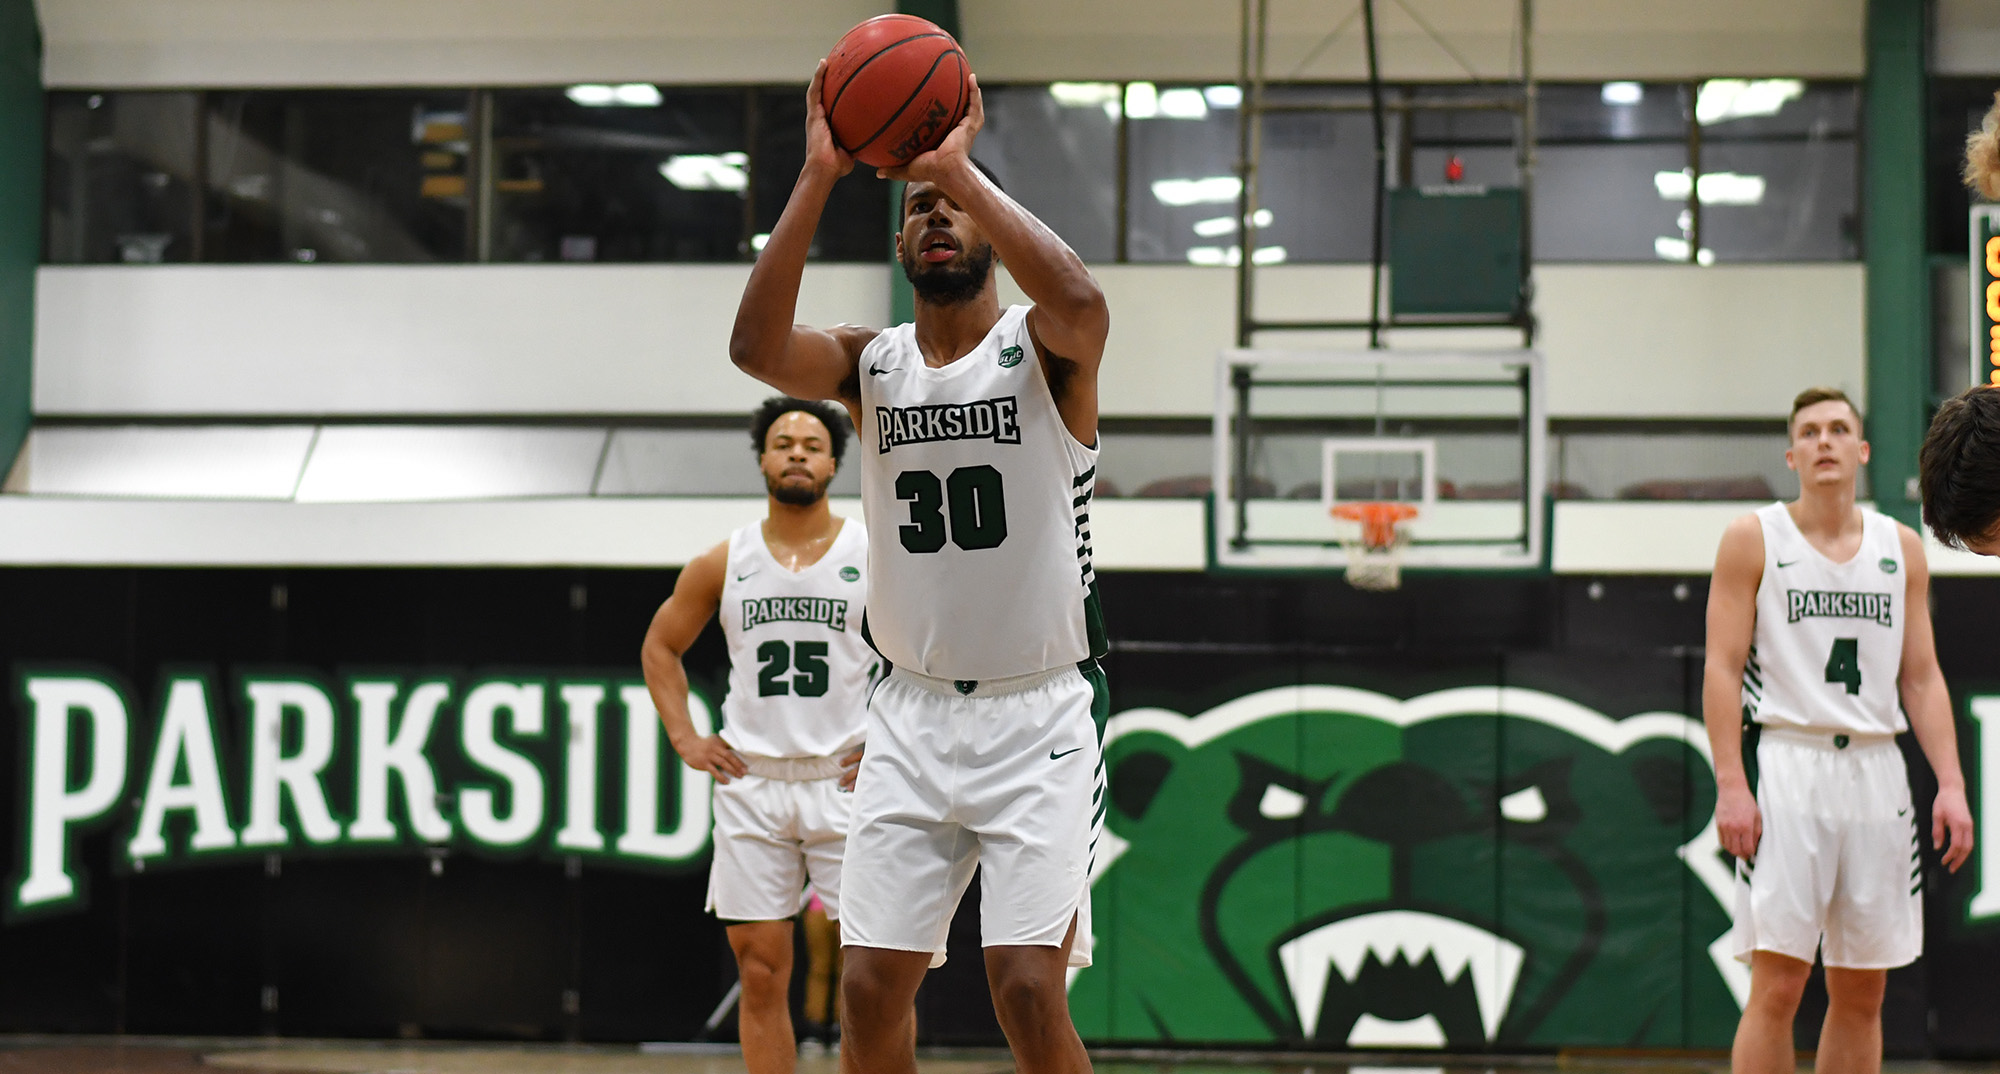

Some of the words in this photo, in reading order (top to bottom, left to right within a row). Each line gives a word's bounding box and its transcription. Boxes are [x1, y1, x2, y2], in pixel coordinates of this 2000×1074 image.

[876, 396, 1021, 454] PARKSIDE
[895, 465, 1008, 553] 30
[742, 597, 847, 632] PARKSIDE
[1787, 589, 1892, 628] PARKSIDE
[757, 640, 829, 697] 25
[1825, 637, 1861, 695] 4
